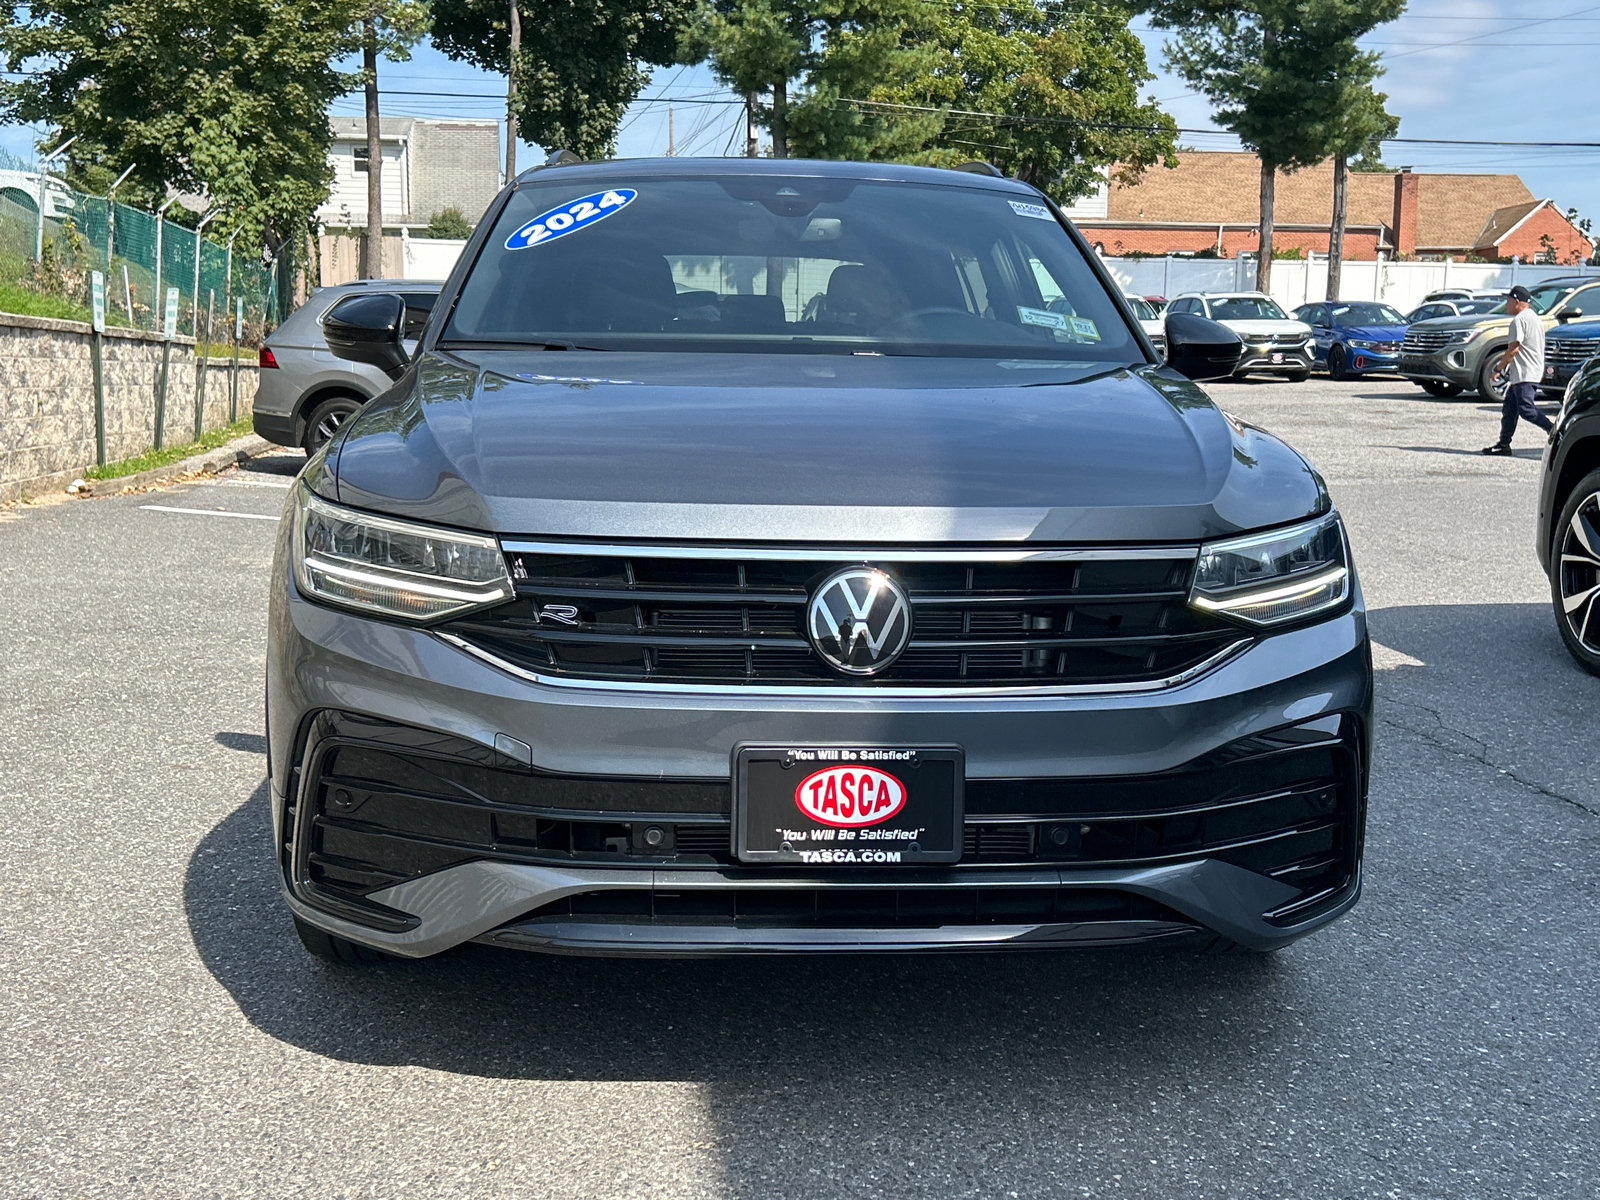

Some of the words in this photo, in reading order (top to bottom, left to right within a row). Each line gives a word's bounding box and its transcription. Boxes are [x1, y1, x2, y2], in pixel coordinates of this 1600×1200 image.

[520, 191, 626, 245] 2024
[813, 575, 906, 663] VW
[818, 750, 838, 760] Will
[841, 750, 857, 760] Be
[809, 772, 892, 818] TASCA
[811, 829, 835, 840] Will
[838, 829, 856, 840] Be
[799, 851, 901, 863] TASCA.COM
